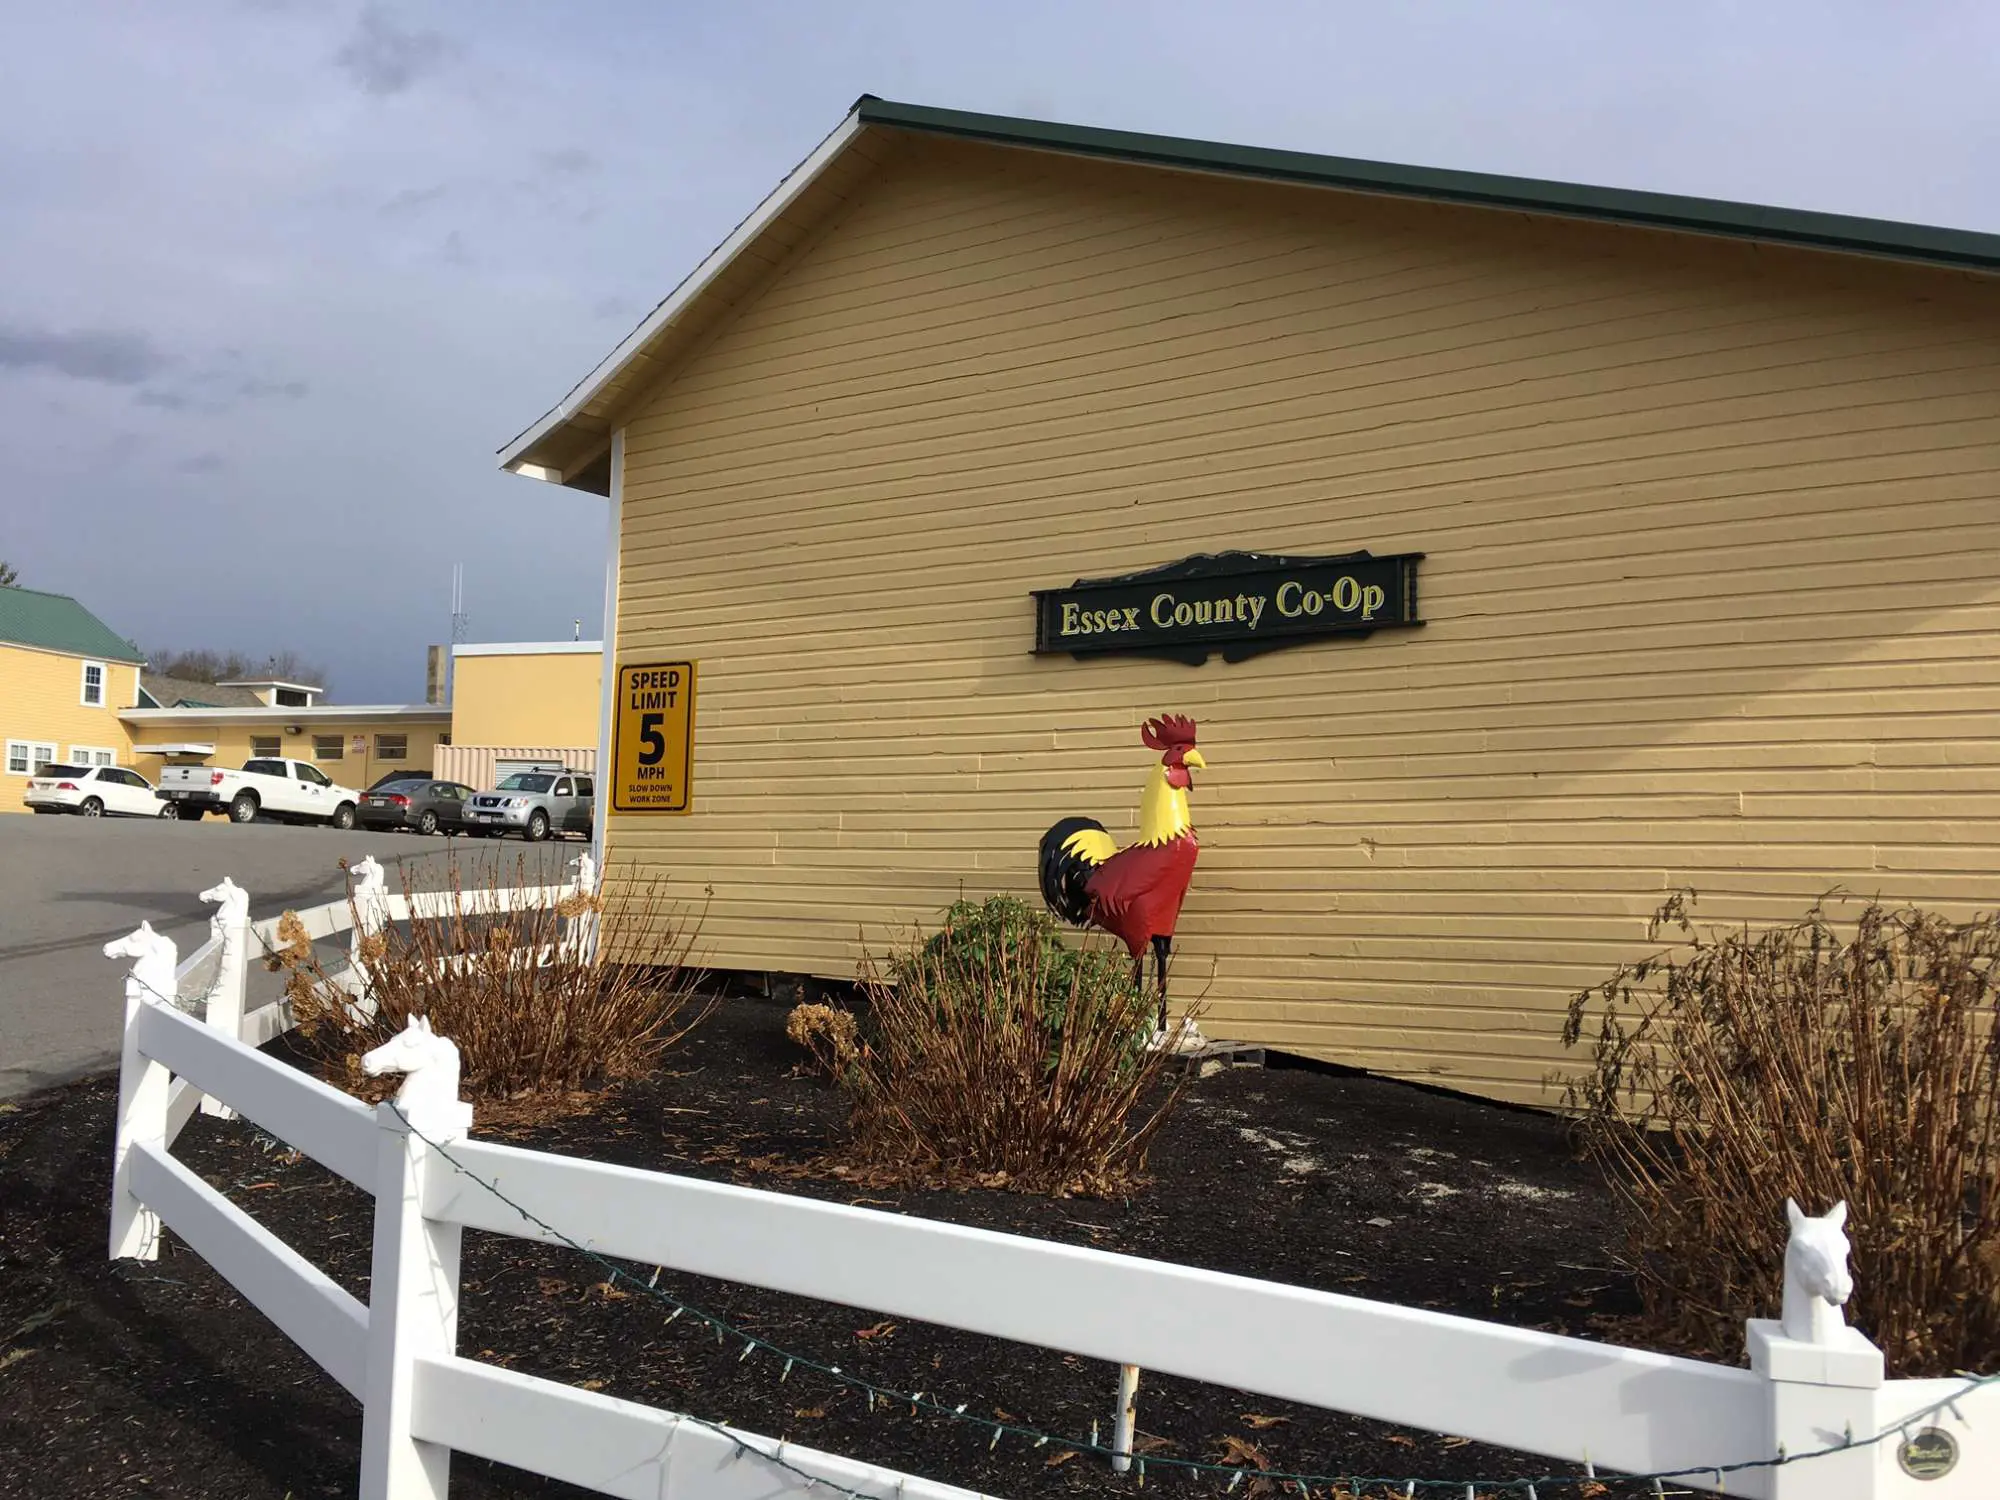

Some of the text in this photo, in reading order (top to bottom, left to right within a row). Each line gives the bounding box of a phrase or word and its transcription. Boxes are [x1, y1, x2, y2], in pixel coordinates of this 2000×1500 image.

[1059, 576, 1385, 636] Essex County Co-Op
[630, 671, 680, 690] SPEED
[631, 691, 678, 710] LIMIT
[638, 713, 665, 765] 5
[637, 767, 665, 780] MPH
[628, 783, 672, 793] SLOW DOWN
[629, 795, 671, 803] WORK ZONE
